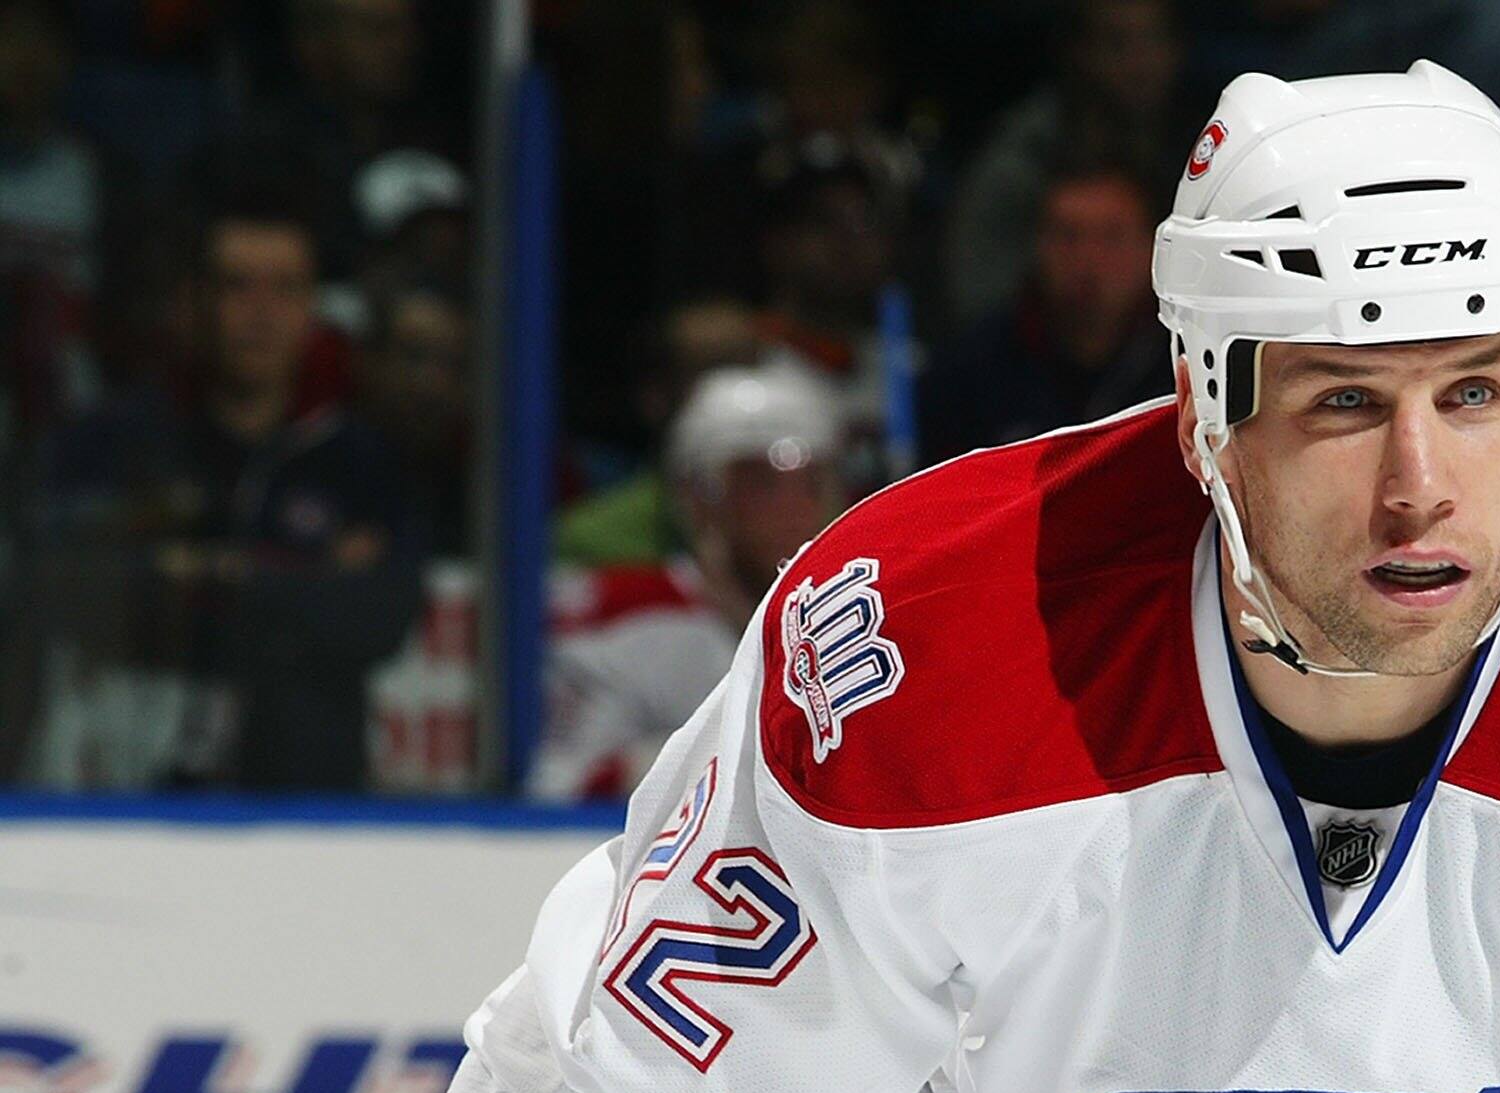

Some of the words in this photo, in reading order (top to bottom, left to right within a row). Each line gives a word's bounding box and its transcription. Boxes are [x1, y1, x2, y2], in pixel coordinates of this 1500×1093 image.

[1353, 238, 1488, 270] CCM
[799, 562, 895, 715] 100
[1327, 838, 1364, 874] NHL
